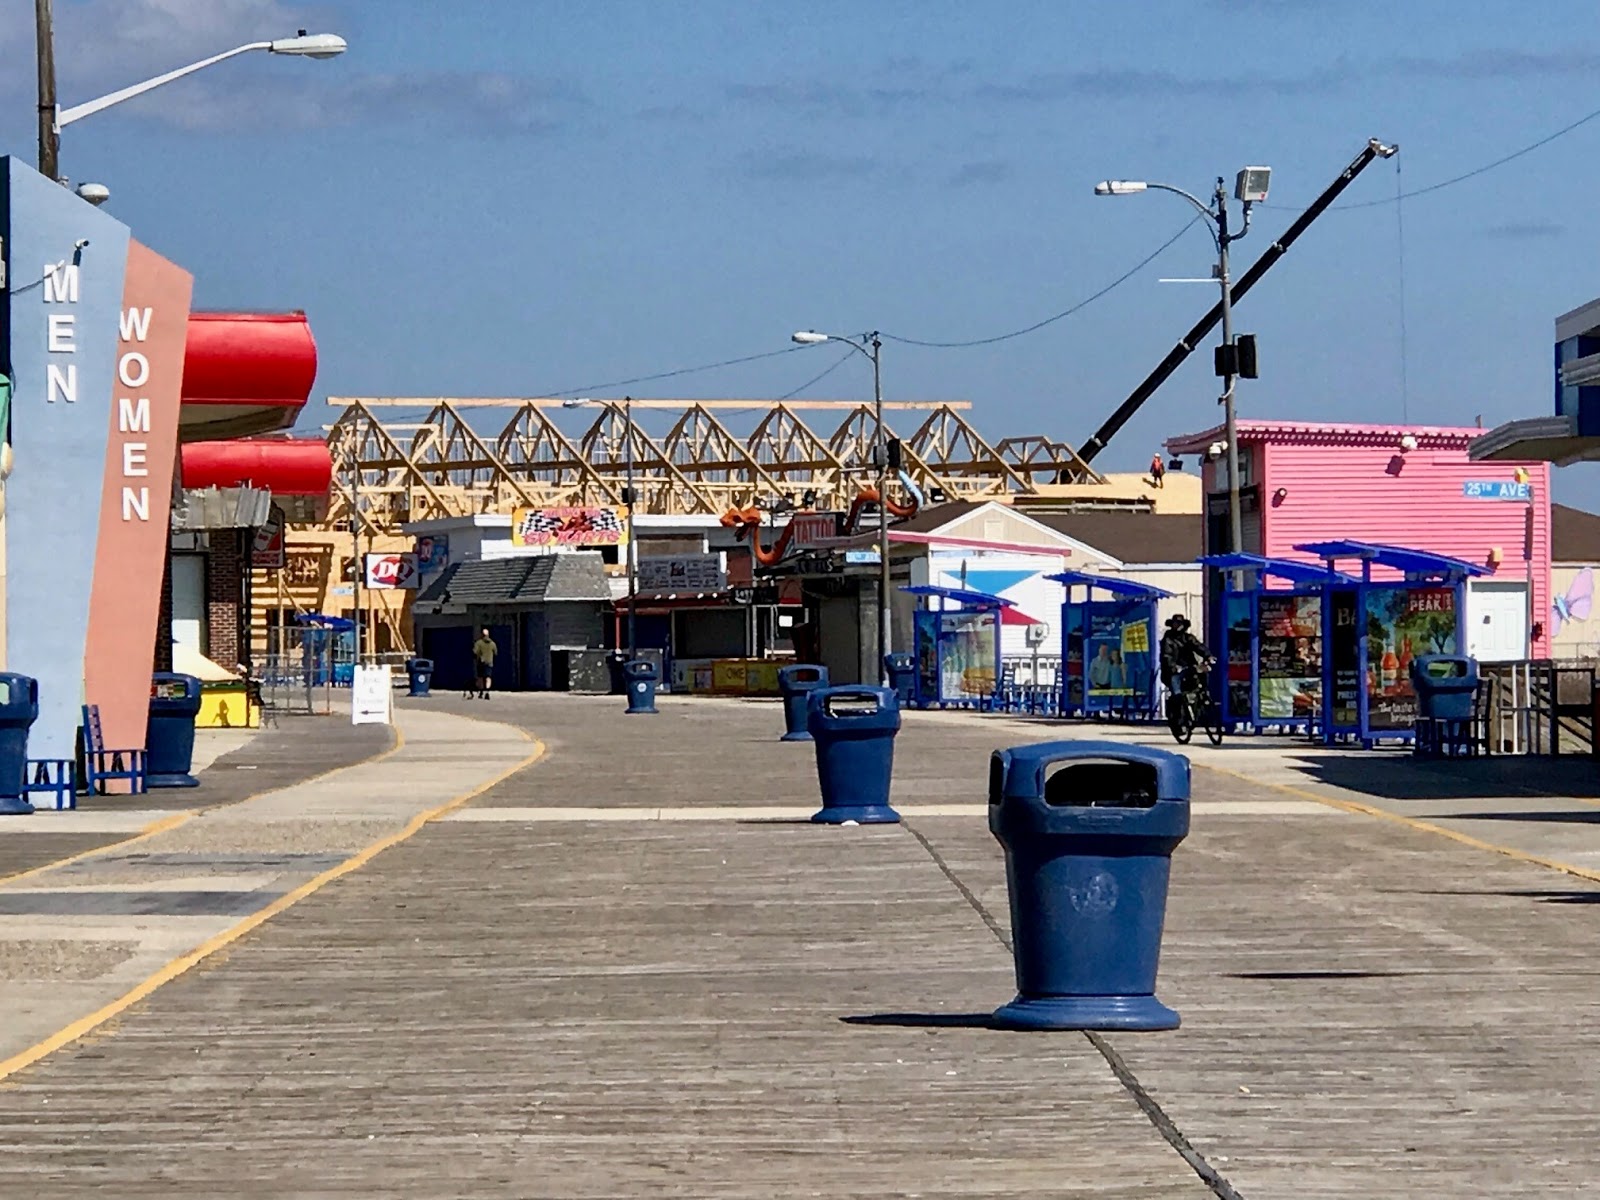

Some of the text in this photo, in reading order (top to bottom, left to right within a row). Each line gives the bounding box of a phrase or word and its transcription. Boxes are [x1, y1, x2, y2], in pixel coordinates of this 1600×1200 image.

[43, 264, 78, 403] MEN
[118, 307, 152, 521] WOMEN
[1467, 482, 1526, 497] 25TH AVE
[377, 561, 413, 580] DQ
[1409, 599, 1441, 611] PEAK
